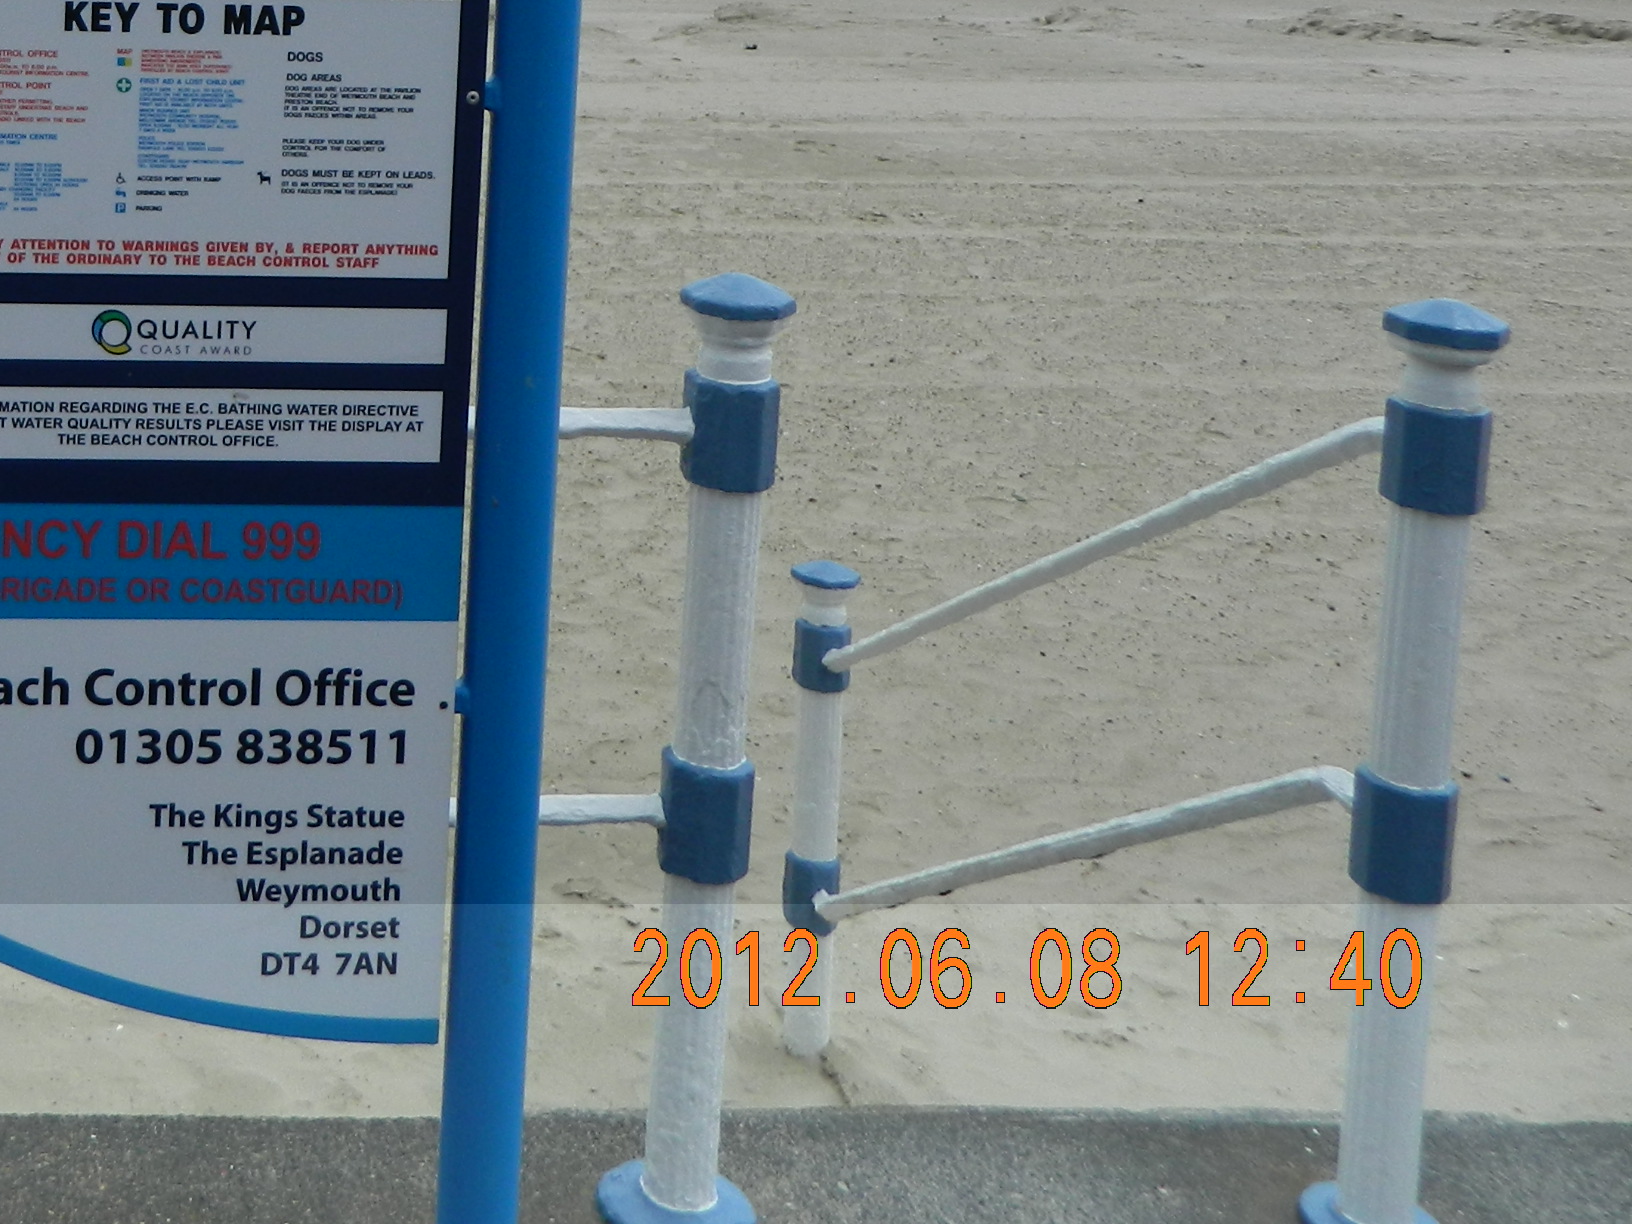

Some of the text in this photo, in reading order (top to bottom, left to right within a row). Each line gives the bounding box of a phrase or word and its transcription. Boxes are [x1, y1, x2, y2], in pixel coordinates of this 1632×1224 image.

[64, 0, 305, 36] KEY TO MAP
[287, 51, 323, 62] DOGS
[286, 72, 341, 82] DOG AREAS
[281, 168, 435, 179] DOGS MUST BE KEPT ON LEADS.
[10, 238, 91, 251] ATTENTION
[97, 240, 116, 251] TO
[122, 240, 200, 252] WARNINGS
[205, 241, 250, 253] GIVEN
[255, 242, 279, 255] BY,
[285, 243, 295, 254] &
[302, 243, 360, 255] REPORT
[365, 244, 439, 256] ANYTHING
[7, 252, 26, 263] OF
[32, 252, 59, 264] THE
[66, 252, 142, 265] ORDINARY
[148, 254, 167, 265] TO
[173, 254, 200, 266] THE
[207, 254, 255, 266] BEACH
[262, 254, 329, 268] CONTROL
[336, 256, 379, 268] STAFF
[137, 319, 256, 340] QUALITY
[139, 344, 251, 355] COAST AWARD
[59, 401, 147, 414] REGARDING
[152, 402, 180, 414] THE
[185, 402, 212, 414] E.C.
[218, 402, 282, 415] BATHING
[286, 403, 337, 416] WATER
[342, 404, 418, 416] DIRECTIVE
[11, 417, 62, 429] WATER
[67, 417, 131, 429] QUALITY
[135, 417, 201, 430] RESULTS
[206, 418, 263, 431] PLEASE
[268, 419, 304, 431] VISIT
[308, 419, 336, 431] THE
[341, 420, 402, 432] DISPLAY
[405, 420, 423, 432] AT
[57, 433, 278, 447] THE BEACH CONTROL OFFICE.
[117, 519, 227, 560] DIAL
[242, 521, 320, 561] 999
[125, 577, 170, 604] OR
[179, 577, 403, 611] COASTGUARD)
[84, 667, 261, 707] Control
[276, 667, 415, 707] Office
[75, 728, 405, 765] 01305 838511
[149, 802, 404, 834] The Kings Statue
[182, 839, 403, 871] The Esplanade
[236, 876, 400, 908] Weymouth
[299, 915, 400, 939] Dorset
[261, 951, 397, 976] DT4 7AN
